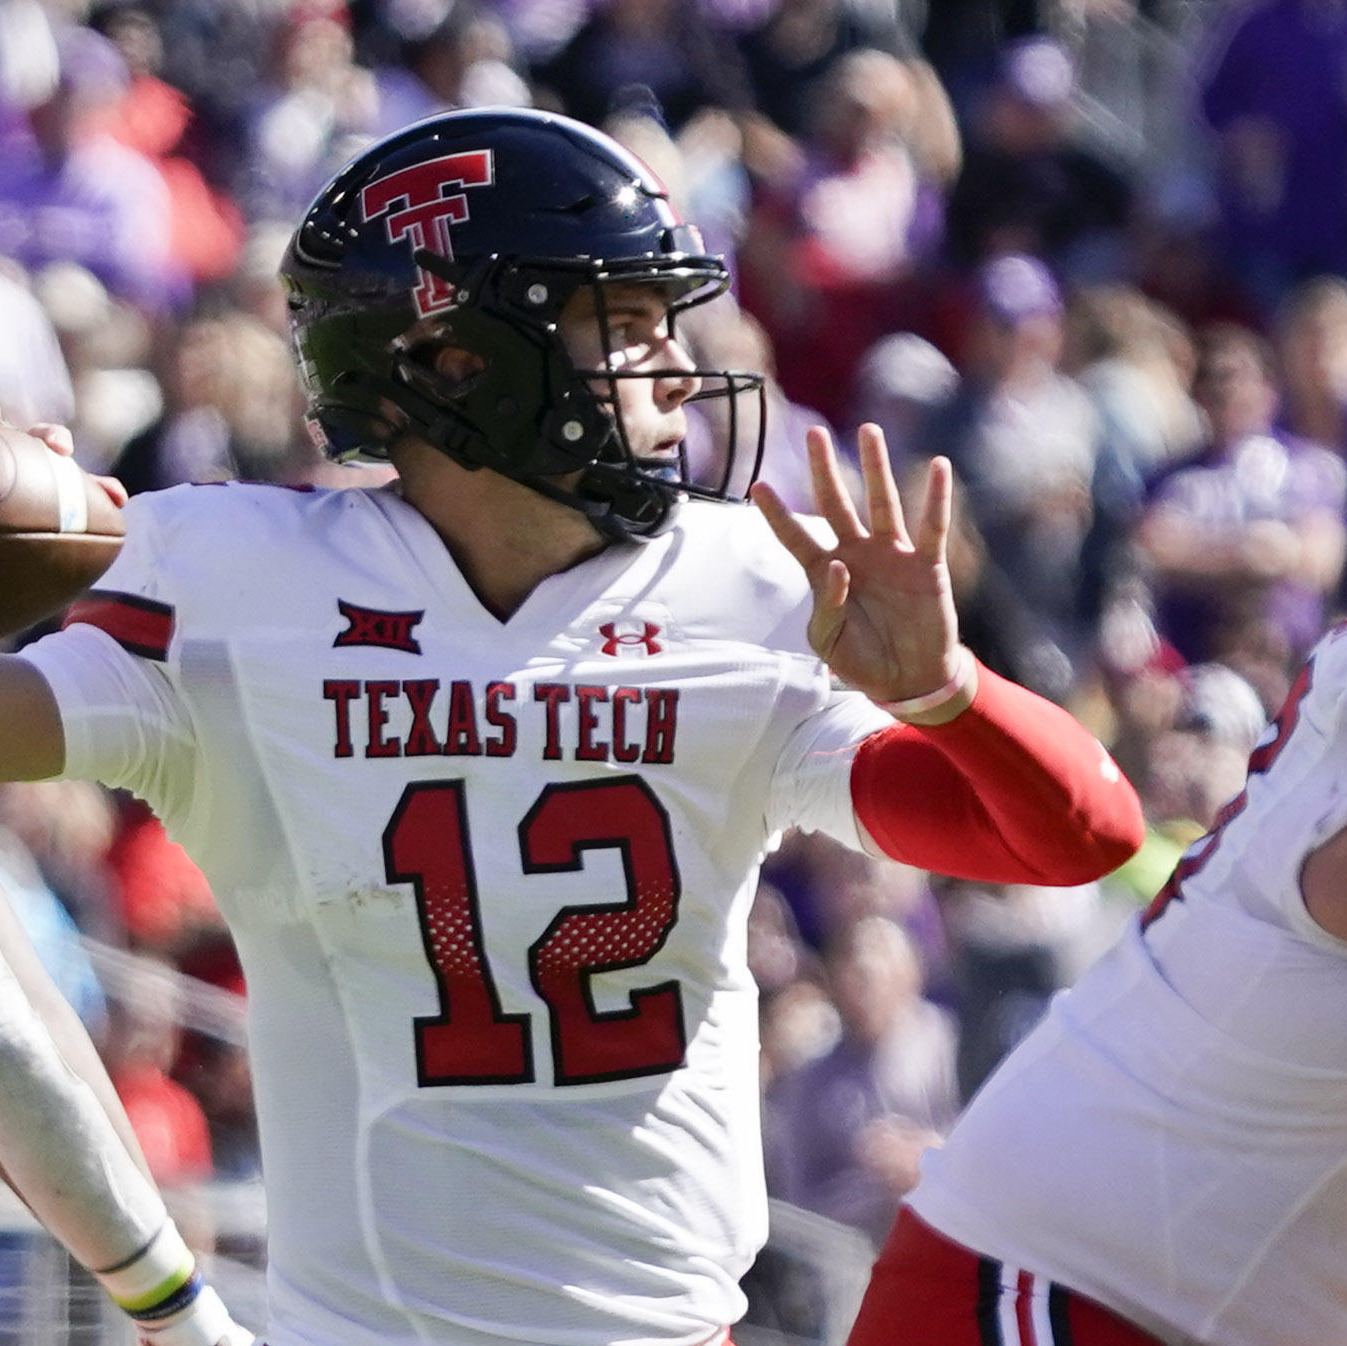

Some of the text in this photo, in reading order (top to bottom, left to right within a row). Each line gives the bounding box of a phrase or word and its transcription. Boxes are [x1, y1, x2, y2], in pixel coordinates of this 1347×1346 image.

[323, 679, 680, 765] TEXAS TECH
[382, 774, 687, 1087] 12
